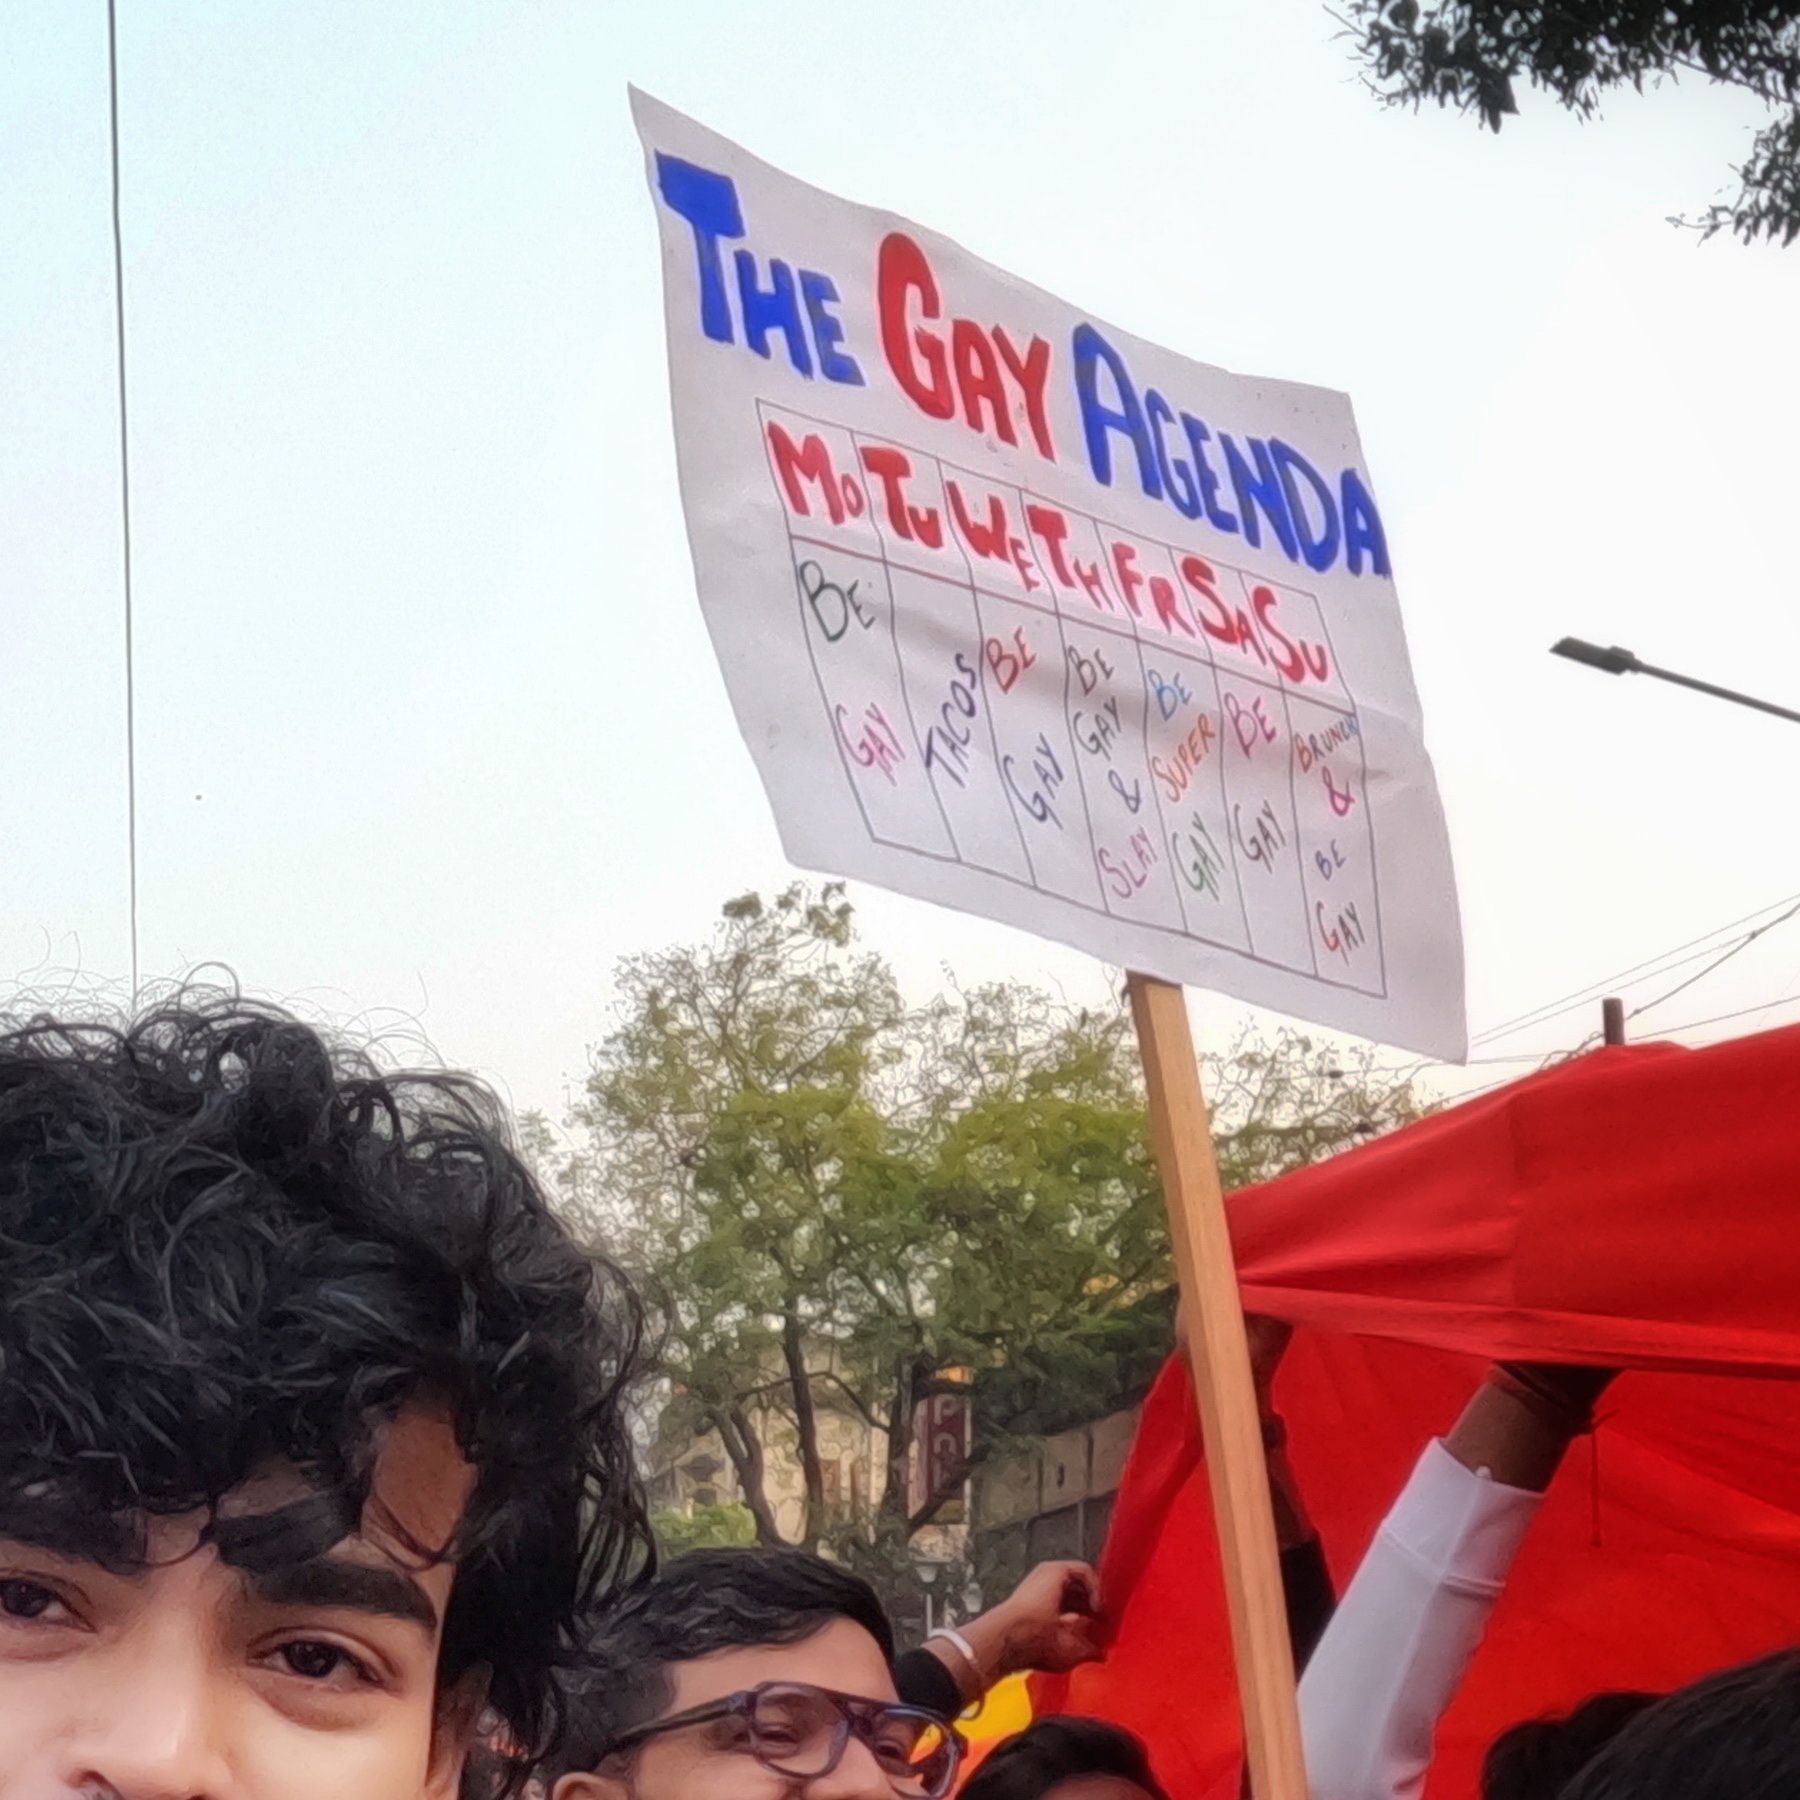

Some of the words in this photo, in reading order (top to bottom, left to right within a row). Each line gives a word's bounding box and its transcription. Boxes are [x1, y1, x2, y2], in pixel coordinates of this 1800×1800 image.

[654, 148, 867, 387] THE
[876, 231, 1057, 463] GAY
[1071, 322, 1393, 579] AGENDA
[798, 560, 876, 643] BE
[986, 626, 1037, 695] BE
[1068, 645, 1115, 697] BE
[1148, 669, 1193, 723] BE
[835, 701, 907, 788] GAY
[924, 653, 977, 789] TACOS
[1072, 696, 1123, 762] GAY
[1152, 713, 1217, 803] SUPER
[1224, 692, 1277, 759] BE
[1002, 732, 1065, 830] GAY
[1098, 824, 1158, 899] SLAY
[1171, 811, 1226, 903] GAY
[1234, 799, 1287, 875] GAY
[1314, 838, 1347, 881] BE
[1316, 900, 1365, 967] GAY
